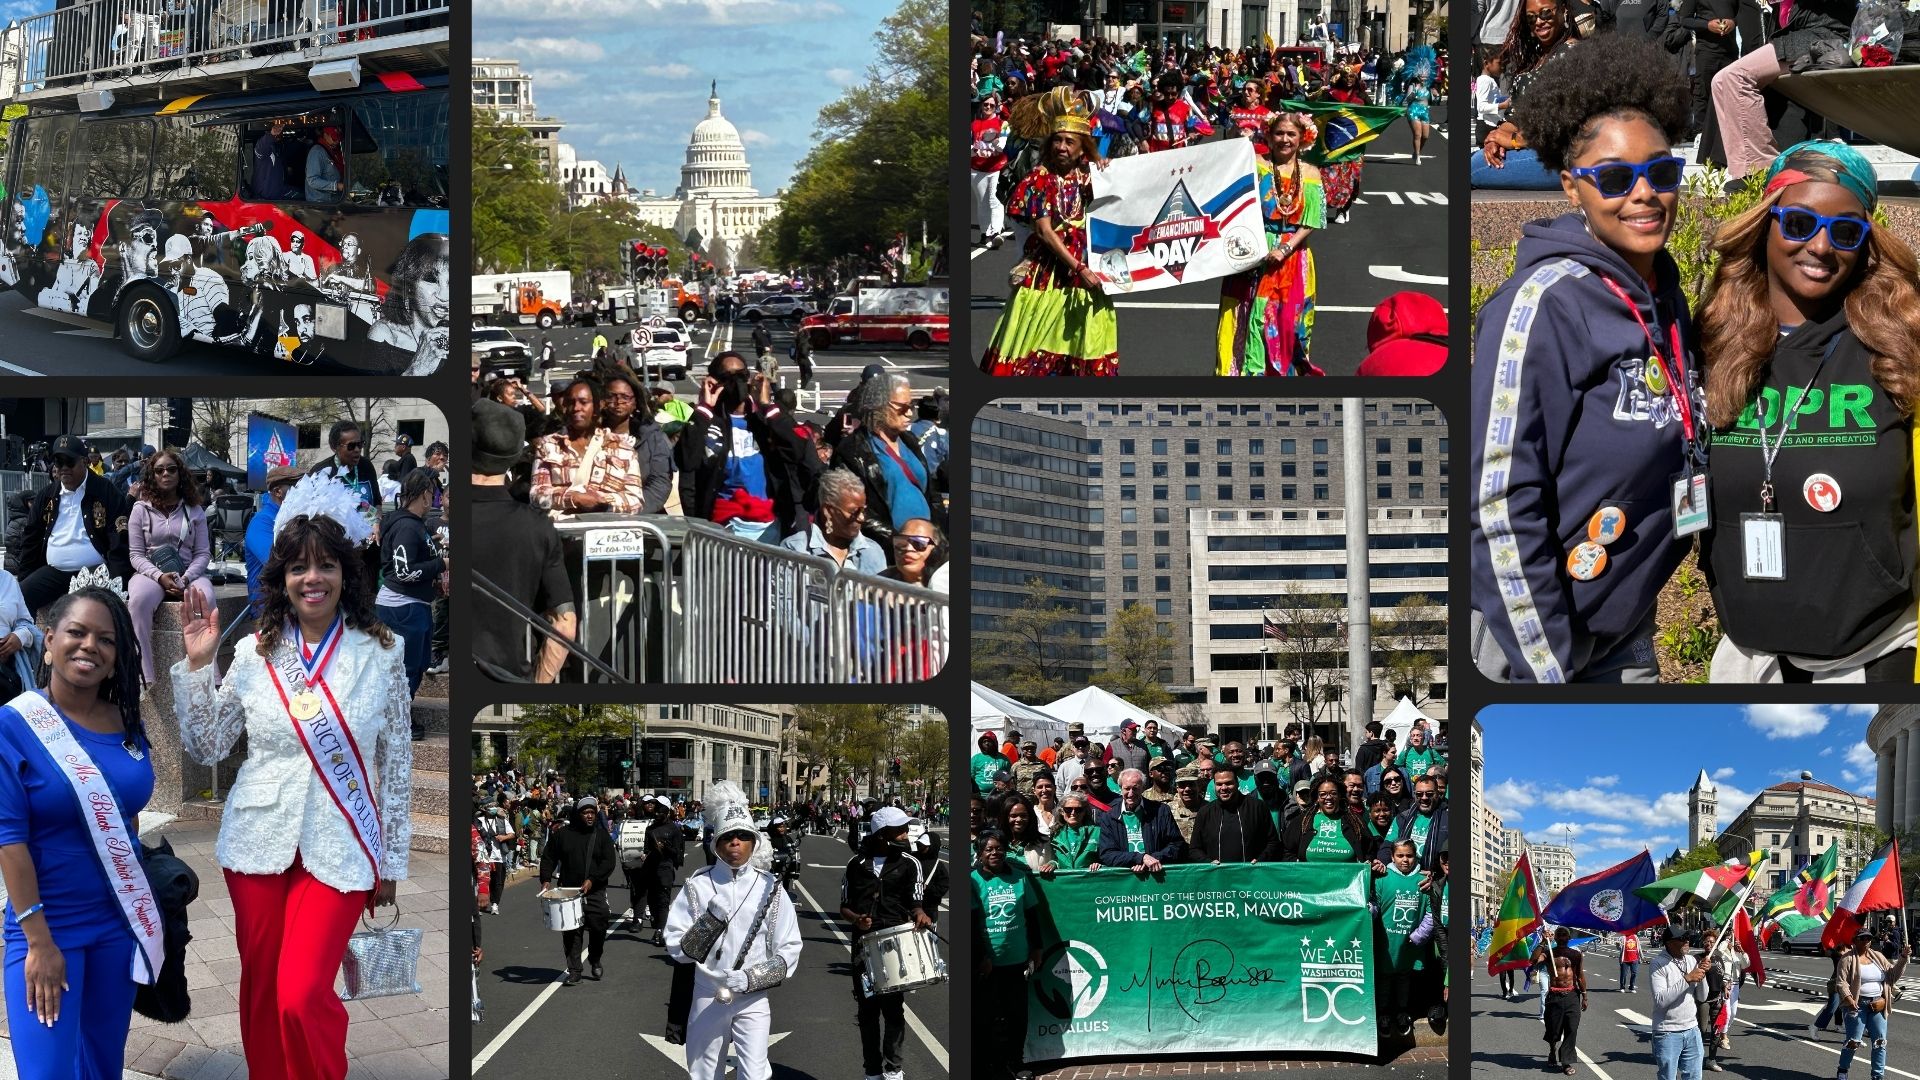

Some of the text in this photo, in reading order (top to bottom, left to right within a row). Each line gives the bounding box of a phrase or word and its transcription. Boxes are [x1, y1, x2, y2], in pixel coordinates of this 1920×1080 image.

[1157, 218, 1205, 239] EMANCIPATION
[1153, 236, 1196, 267] DAY
[1737, 383, 1878, 430] DPR
[1767, 437, 1793, 445] PAKS
[1795, 436, 1814, 444] AND
[1817, 435, 1876, 444] RECREATION
[281, 658, 306, 687] MS.
[45, 728, 66, 744] 2025
[333, 762, 355, 783] OF
[347, 788, 383, 862] COLUMB
[64, 754, 155, 937] Ms. Black District of Columbia
[1095, 890, 1302, 905] GOVERNMENT OF THE DISTRICT OF COLUMBIA
[989, 901, 1016, 919] DC
[1096, 902, 1303, 923] MURIEL BOWSER, MAYOR
[1393, 906, 1418, 923] DC
[1300, 948, 1364, 964] WE ARE
[1301, 968, 1365, 978] WASHINGTON
[1301, 983, 1367, 1025] DC
